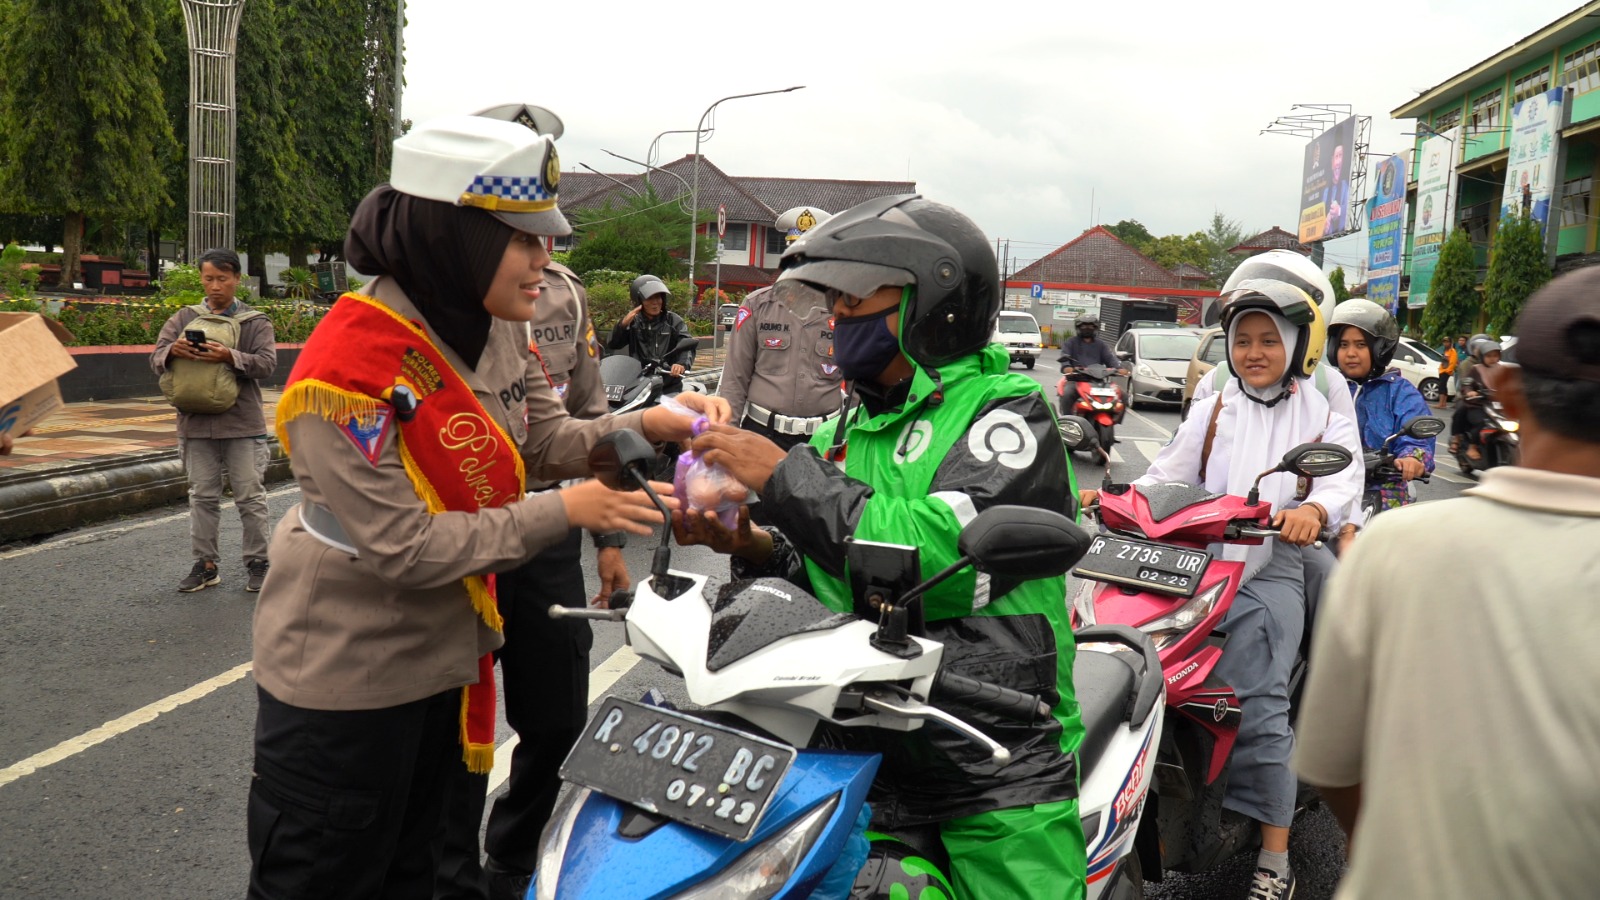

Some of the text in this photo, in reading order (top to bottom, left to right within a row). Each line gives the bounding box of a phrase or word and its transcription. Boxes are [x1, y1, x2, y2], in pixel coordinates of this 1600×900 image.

[1033, 284, 1041, 297] P
[533, 324, 575, 344] POLRI
[760, 322, 782, 331] AGUNG
[412, 351, 441, 383] POLRES
[439, 412, 501, 508] Polres
[1090, 540, 1201, 572] R 2736 UR
[751, 584, 792, 602] HONDA
[1167, 661, 1199, 685] HONDA
[594, 707, 776, 792] R 4812 BC
